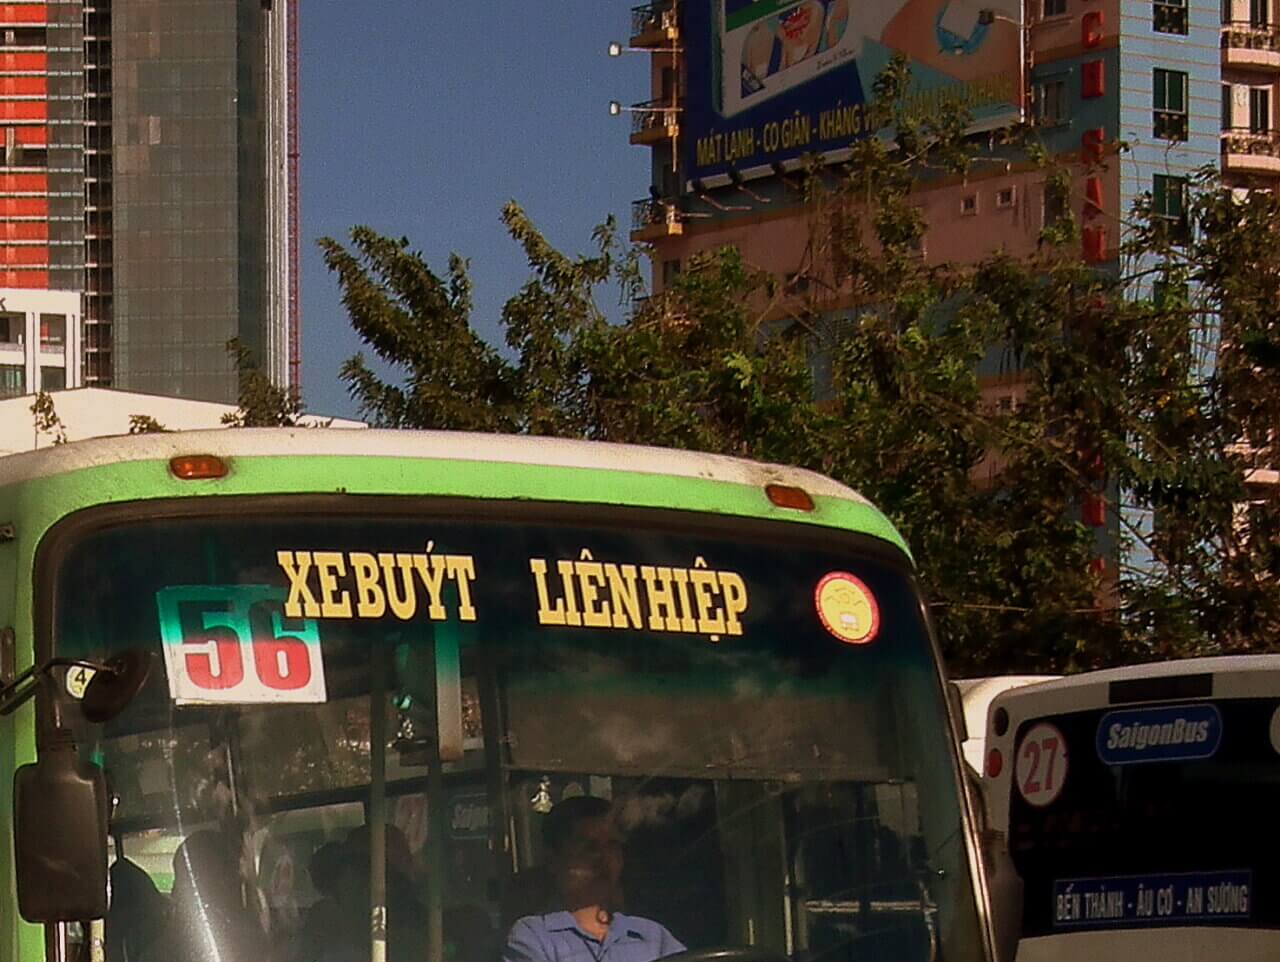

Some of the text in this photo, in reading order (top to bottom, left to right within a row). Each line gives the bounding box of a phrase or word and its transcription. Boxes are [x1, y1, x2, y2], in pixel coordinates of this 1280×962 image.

[696, 128, 722, 167] MÁT
[724, 126, 755, 166] LẠNH
[763, 122, 780, 153] CO
[277, 551, 353, 618] XE
[349, 540, 476, 620] BUÝT
[530, 548, 643, 629] LIÊN
[640, 556, 748, 642] HIỆP
[177, 600, 312, 691] 56
[1106, 716, 1209, 751] SaigonBus
[1022, 737, 1059, 795] 27
[1056, 883, 1081, 920] BẾN
[1084, 884, 1124, 918] THÀNH
[1136, 883, 1154, 917] ÂU
[1185, 887, 1204, 914] AN
